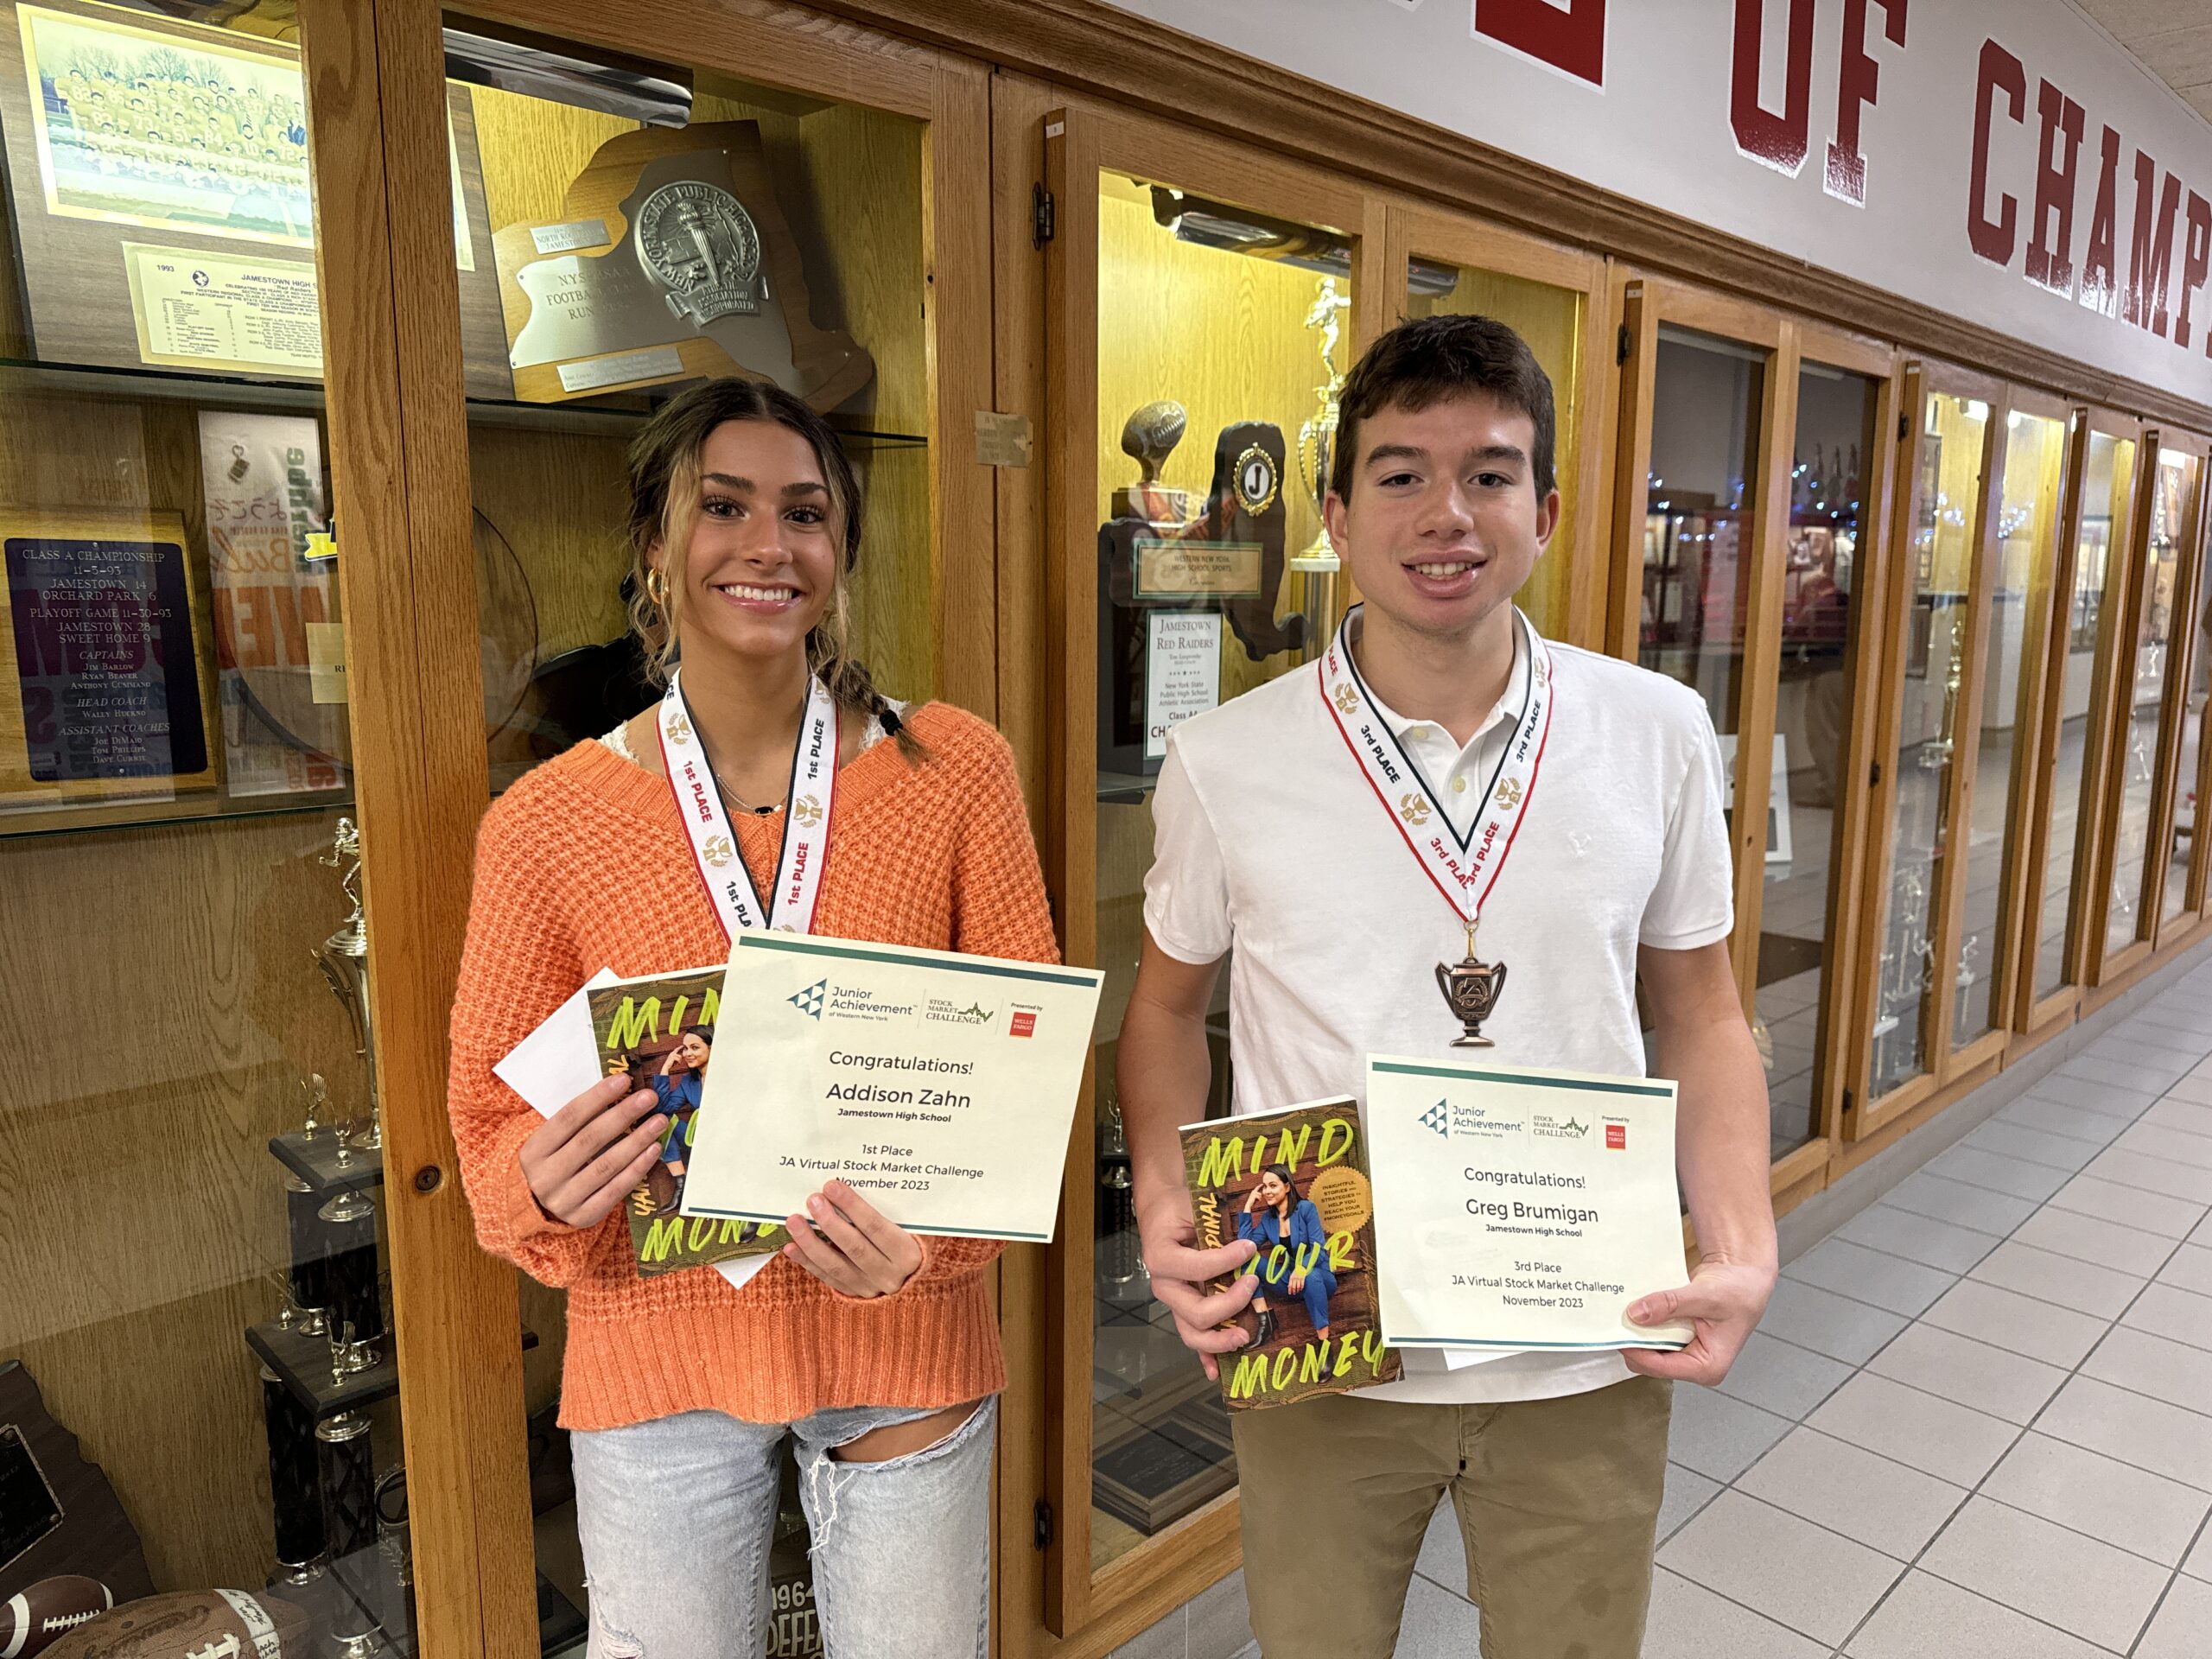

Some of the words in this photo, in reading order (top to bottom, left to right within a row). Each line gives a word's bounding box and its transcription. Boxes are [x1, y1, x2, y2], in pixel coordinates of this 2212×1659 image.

[1730, 0, 1907, 208] OF
[1967, 36, 2212, 356] CHAMP
[674, 185, 727, 207] PUBLIC
[241, 273, 290, 286] JAMESTOWN
[292, 279, 311, 288] HIGH
[1249, 466, 1262, 495] J
[22, 549, 60, 560] CLASS
[65, 550, 73, 560] A
[78, 550, 165, 563] CHAMPIONSHIP
[49, 579, 127, 588] JAMESTOWN
[136, 581, 147, 589] 14
[43, 591, 103, 601] ORCHARD
[107, 592, 141, 601] PARK
[29, 607, 84, 618] PLAYOFF
[86, 607, 120, 618] GAME
[123, 608, 172, 618] 11-30-93
[56, 622, 133, 632] JAMESTOWN
[137, 622, 151, 632] 28
[1160, 619, 1211, 634] JAMESTOWN
[60, 633, 101, 644] SWEET
[105, 633, 140, 643] HOME
[143, 633, 150, 642] 9
[1157, 637, 1175, 650] RED
[1178, 637, 1214, 650] RAIDERS
[79, 650, 135, 660] CAPTAINS
[76, 697, 109, 708] HEAD
[111, 696, 148, 706] COACH
[1169, 711, 1186, 721] Class
[59, 724, 120, 736] ASSISTANT
[122, 722, 170, 733] COACHES
[1516, 741, 1529, 763] 3rd
[1525, 699, 1541, 740] PLACE
[810, 718, 824, 758] PLACE
[1360, 725, 1376, 747] 3rd
[1372, 746, 1401, 785] PLACE
[807, 758, 817, 780] 1st
[683, 760, 696, 781] 1st
[691, 782, 713, 823] PLACE
[1430, 837, 1450, 861] 3rd
[1467, 862, 1483, 886] 3rd
[1478, 821, 1500, 861] PLACE
[792, 842, 809, 882] PLACE
[787, 883, 801, 906] 1st
[726, 880, 740, 902] 1st
[734, 904, 753, 928] PLA
[832, 986, 873, 1001] Junior
[927, 1005, 959, 1014] MARKET
[929, 999, 953, 1007] STOCK
[1011, 1001, 1036, 1010] Presented
[607, 987, 721, 1049] MIN
[925, 1012, 982, 1026] CHALLENGE
[829, 1050, 974, 1075] Congratulations!
[825, 1082, 913, 1104] Addison
[918, 1089, 972, 1109] Zahn
[836, 1108, 893, 1120] Jamestown
[894, 1110, 918, 1122] High
[919, 1112, 952, 1123] School
[1452, 1105, 1485, 1117] Junior
[1533, 1121, 1560, 1129] MARKET
[1601, 1115, 1623, 1123] Presented
[1533, 1128, 1581, 1140] CHALLENGE
[861, 1144, 878, 1154] 1st
[880, 1144, 913, 1157] Place
[1198, 1118, 1354, 1188] MIND
[779, 1156, 796, 1167] JA
[799, 1158, 841, 1170] Virtual
[842, 1160, 878, 1173] Stock
[880, 1162, 922, 1173] Market
[925, 1165, 984, 1179] Challenge
[1464, 1166, 1586, 1189] Congratulations!
[899, 1179, 931, 1191] 2023
[1322, 1179, 1357, 1191] INSIGHTFUL
[1323, 1187, 1348, 1197] STORIES
[1320, 1192, 1355, 1204] STRATEGIES
[1324, 1207, 1344, 1216] REACH
[1465, 1198, 1509, 1221] Greg
[1513, 1201, 1599, 1225] Brumigan
[1485, 1224, 1534, 1235] Jamestown
[1535, 1226, 1554, 1237] High
[1555, 1228, 1583, 1237] School
[1514, 1261, 1531, 1272] 3rd
[1534, 1262, 1562, 1274] Place
[1451, 1274, 1465, 1286] JA
[1467, 1275, 1503, 1287] Virtual
[1505, 1277, 1535, 1289] Stock
[1536, 1280, 1573, 1291] Market
[1574, 1281, 1625, 1295] Challenge
[1503, 1294, 1556, 1307] November
[1559, 1297, 1584, 1308] 2023
[1230, 1330, 1385, 1400] MONEY
